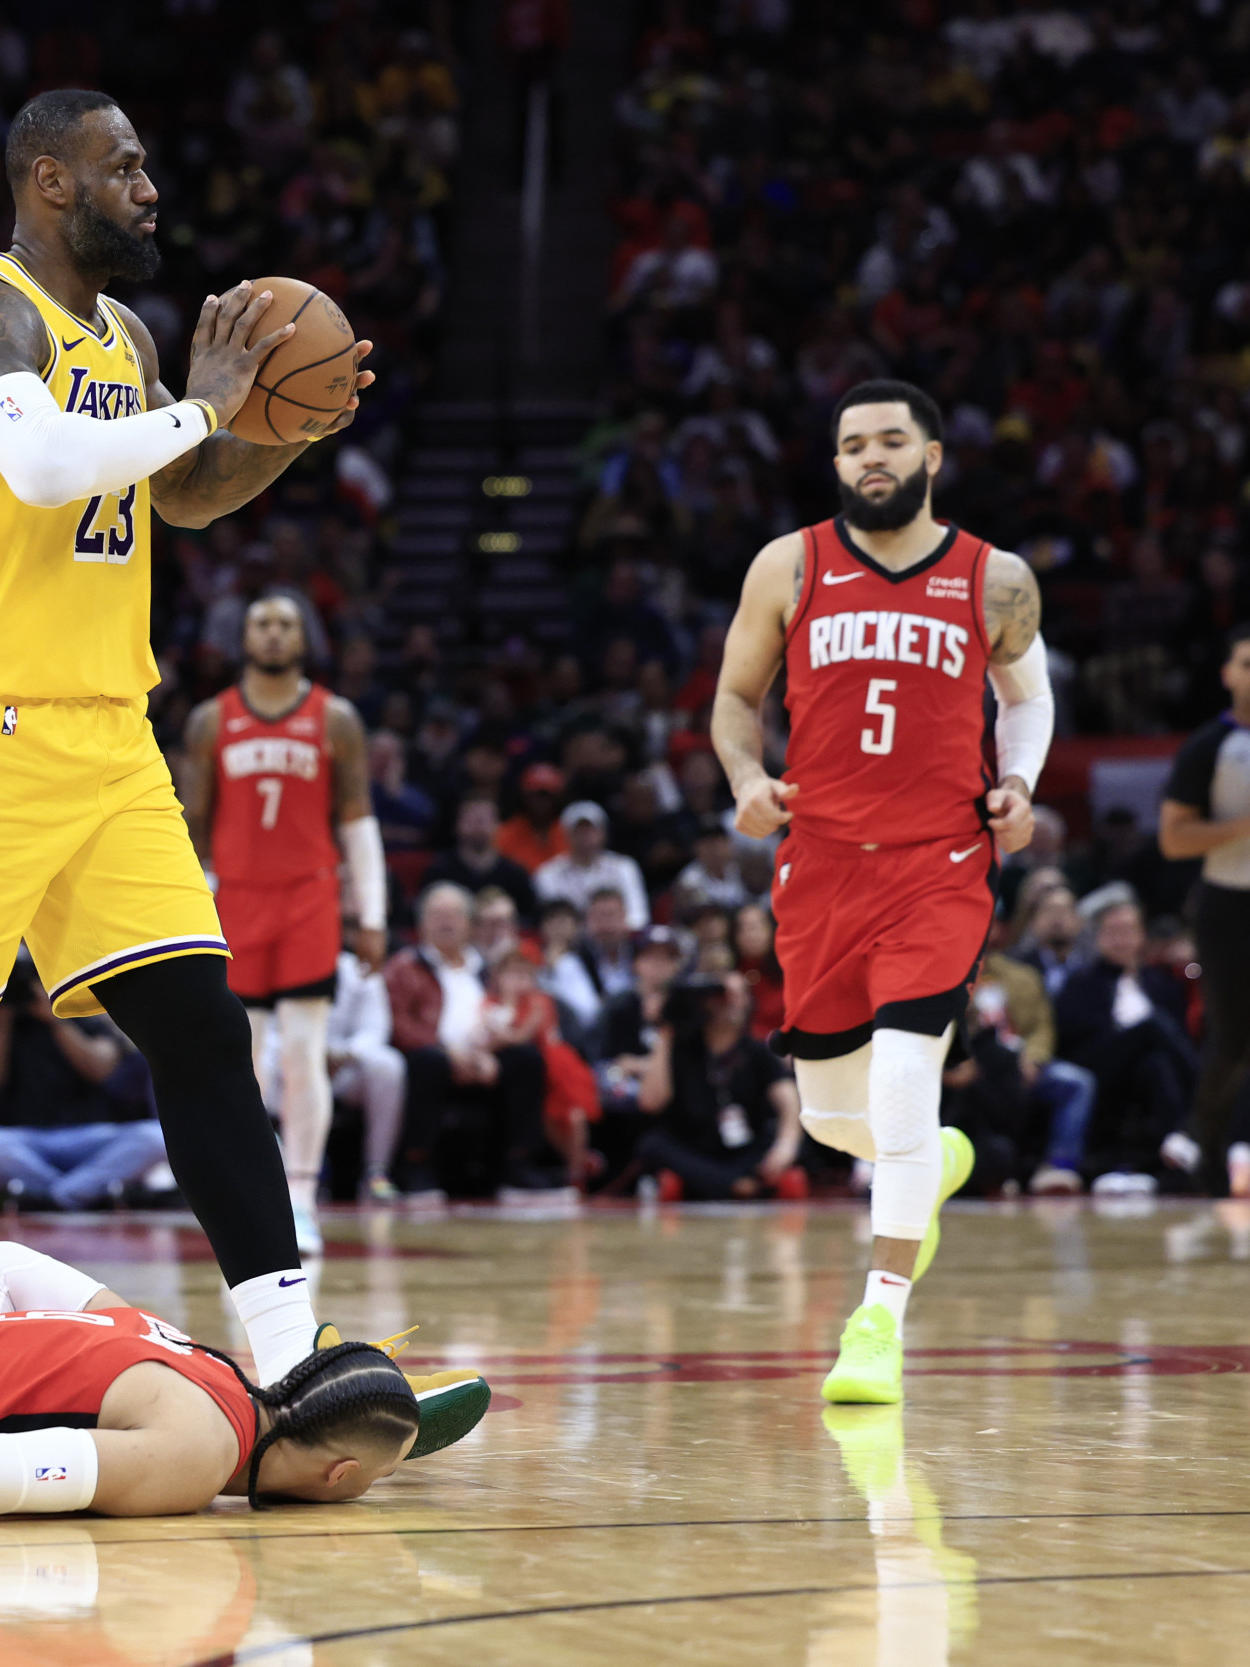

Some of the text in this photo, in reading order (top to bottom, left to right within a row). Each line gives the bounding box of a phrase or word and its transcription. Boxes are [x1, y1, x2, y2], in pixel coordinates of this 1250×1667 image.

[64, 366, 143, 420] LAKERS
[73, 483, 136, 565] 23
[925, 584, 969, 601] karma
[928, 575, 969, 590] credit
[809, 611, 969, 679] ROCKETS
[860, 678, 898, 756] 5
[256, 778, 283, 831] 7
